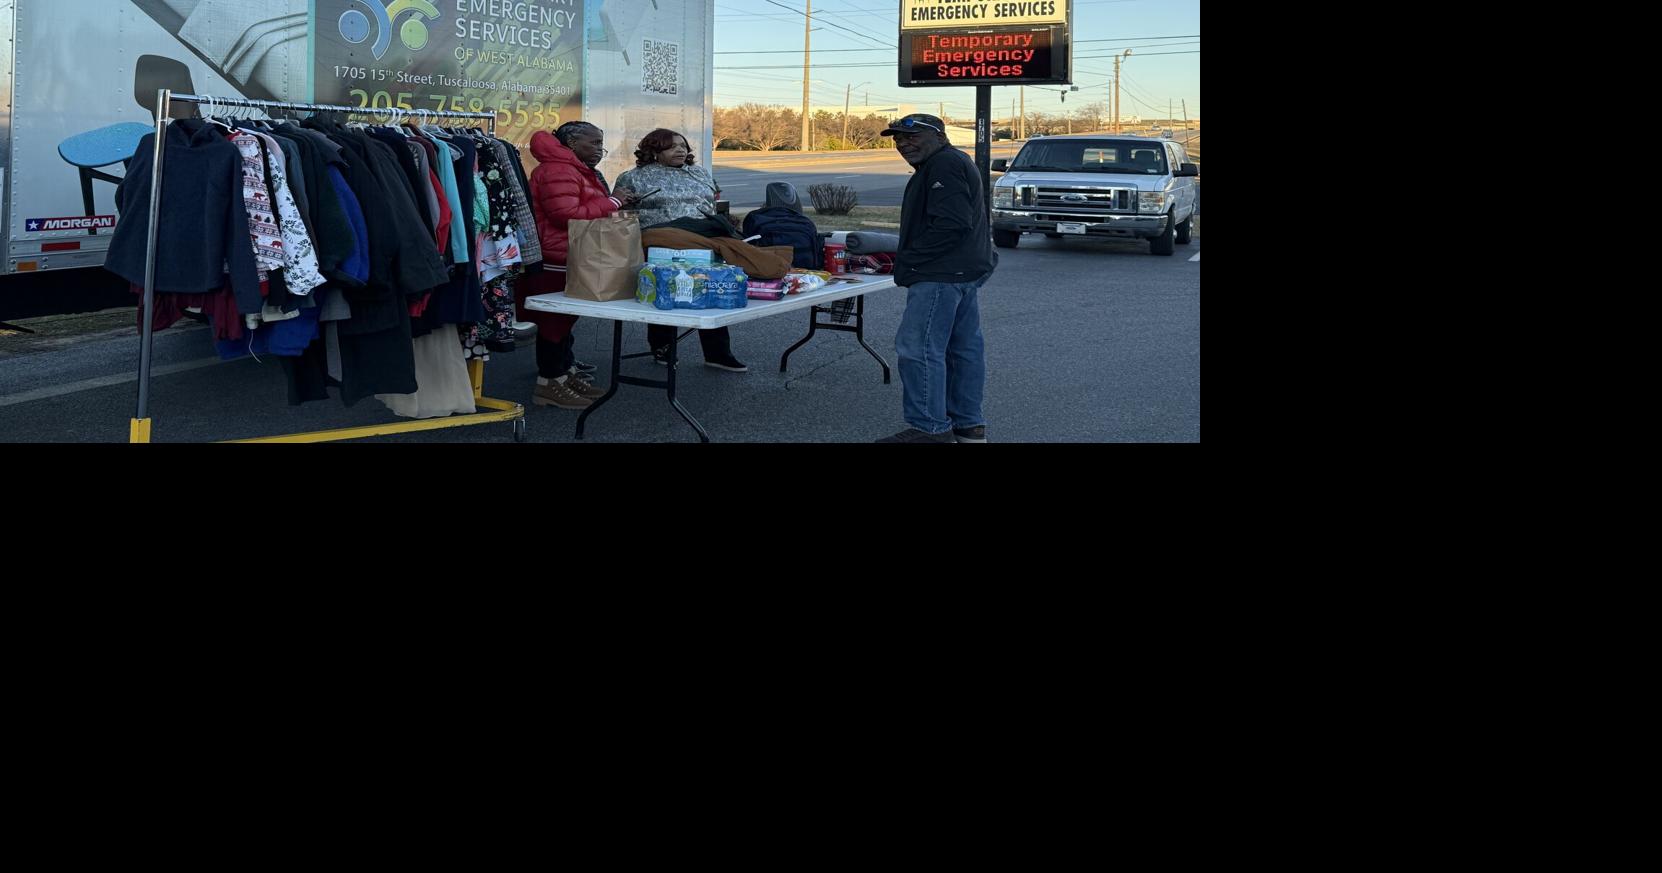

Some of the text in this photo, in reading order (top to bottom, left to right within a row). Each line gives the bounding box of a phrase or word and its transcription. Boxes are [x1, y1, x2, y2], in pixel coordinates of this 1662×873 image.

[456, 0, 576, 29] EMERGENCY
[911, 1, 1056, 21] EMERGENCY SERVICES
[455, 18, 552, 49] SERVICES
[928, 34, 1034, 48] Temporary
[454, 46, 574, 72] OF WEST ALABAMA
[923, 49, 1035, 63] Emergency
[333, 65, 570, 96] 1705 15th Street, Tuscaloosa, Alabama 35401
[937, 63, 1023, 77] Services
[497, 99, 561, 129] 5535
[43, 217, 112, 229] MORGAN
